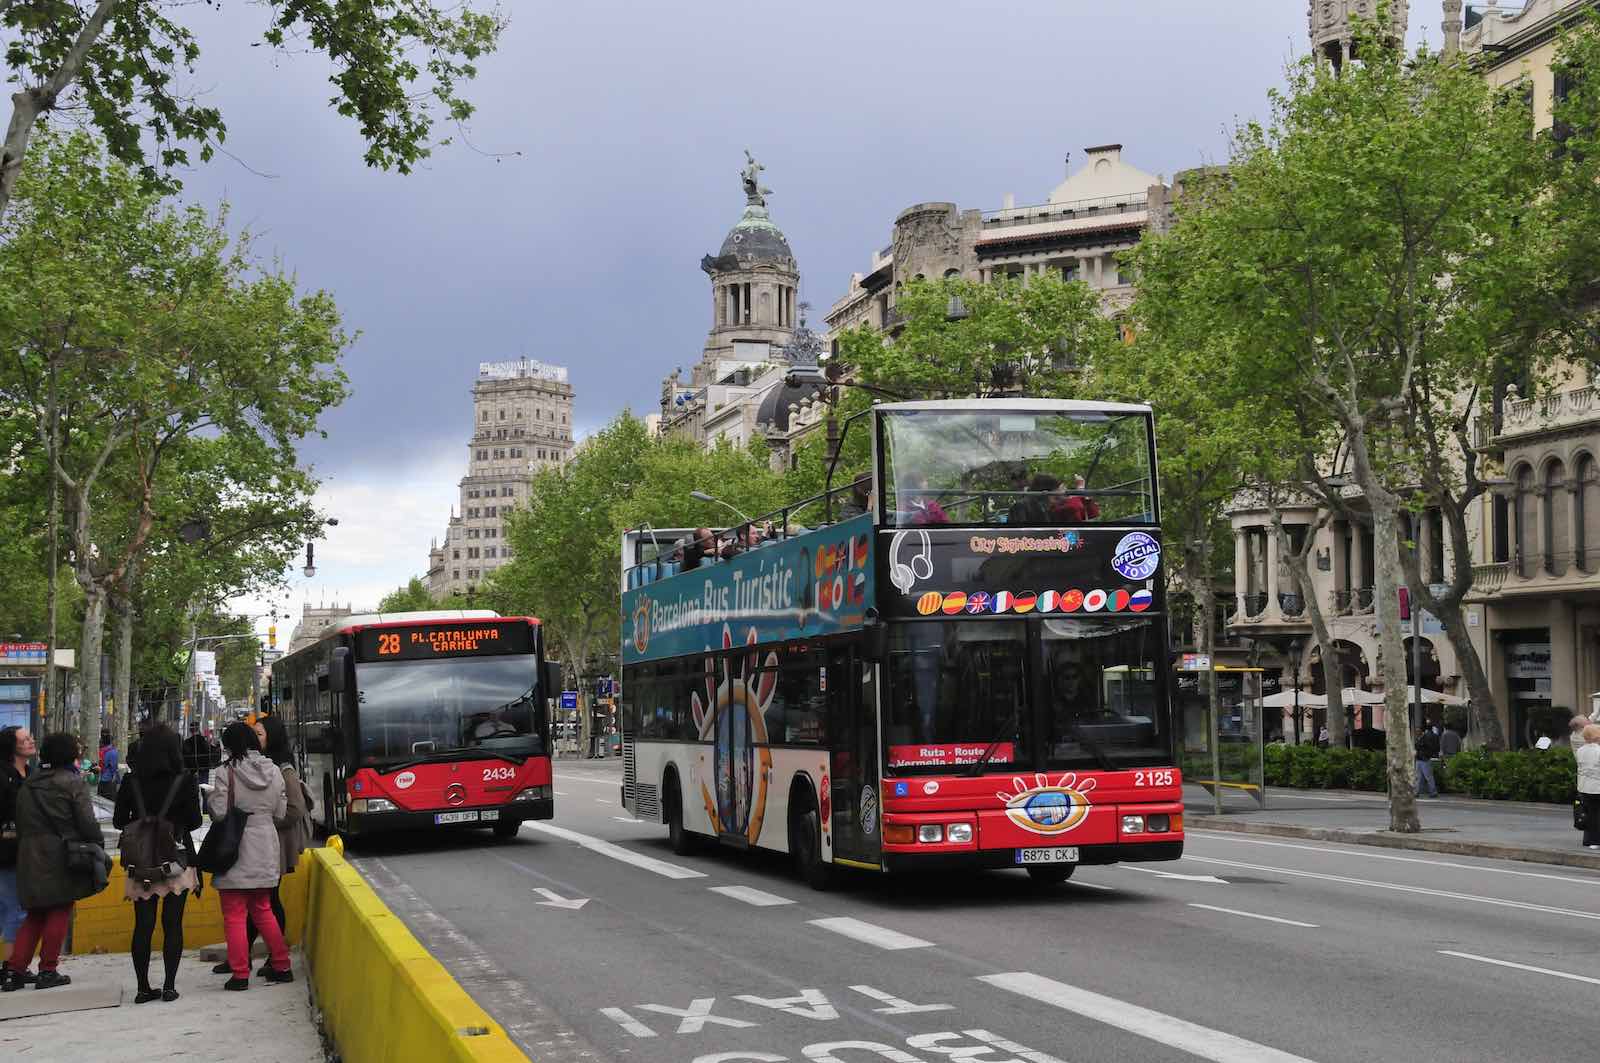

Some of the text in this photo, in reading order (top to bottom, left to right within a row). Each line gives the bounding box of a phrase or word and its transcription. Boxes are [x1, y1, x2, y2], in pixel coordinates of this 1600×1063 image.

[970, 536, 1069, 553] City Sightseeing
[1114, 544, 1157, 567] OFFICIAL
[652, 558, 793, 633] Barcelona Bus Turístic
[378, 629, 499, 655] 28 PL.CATALUNYA
[432, 640, 479, 652] CARMEL
[919, 748, 945, 757] Ruta
[954, 747, 985, 756] Route
[483, 767, 516, 781] 2434
[1135, 772, 1173, 786] 2125
[1023, 849, 1076, 861] 6876 CKJ
[598, 984, 955, 1038] TAXI
